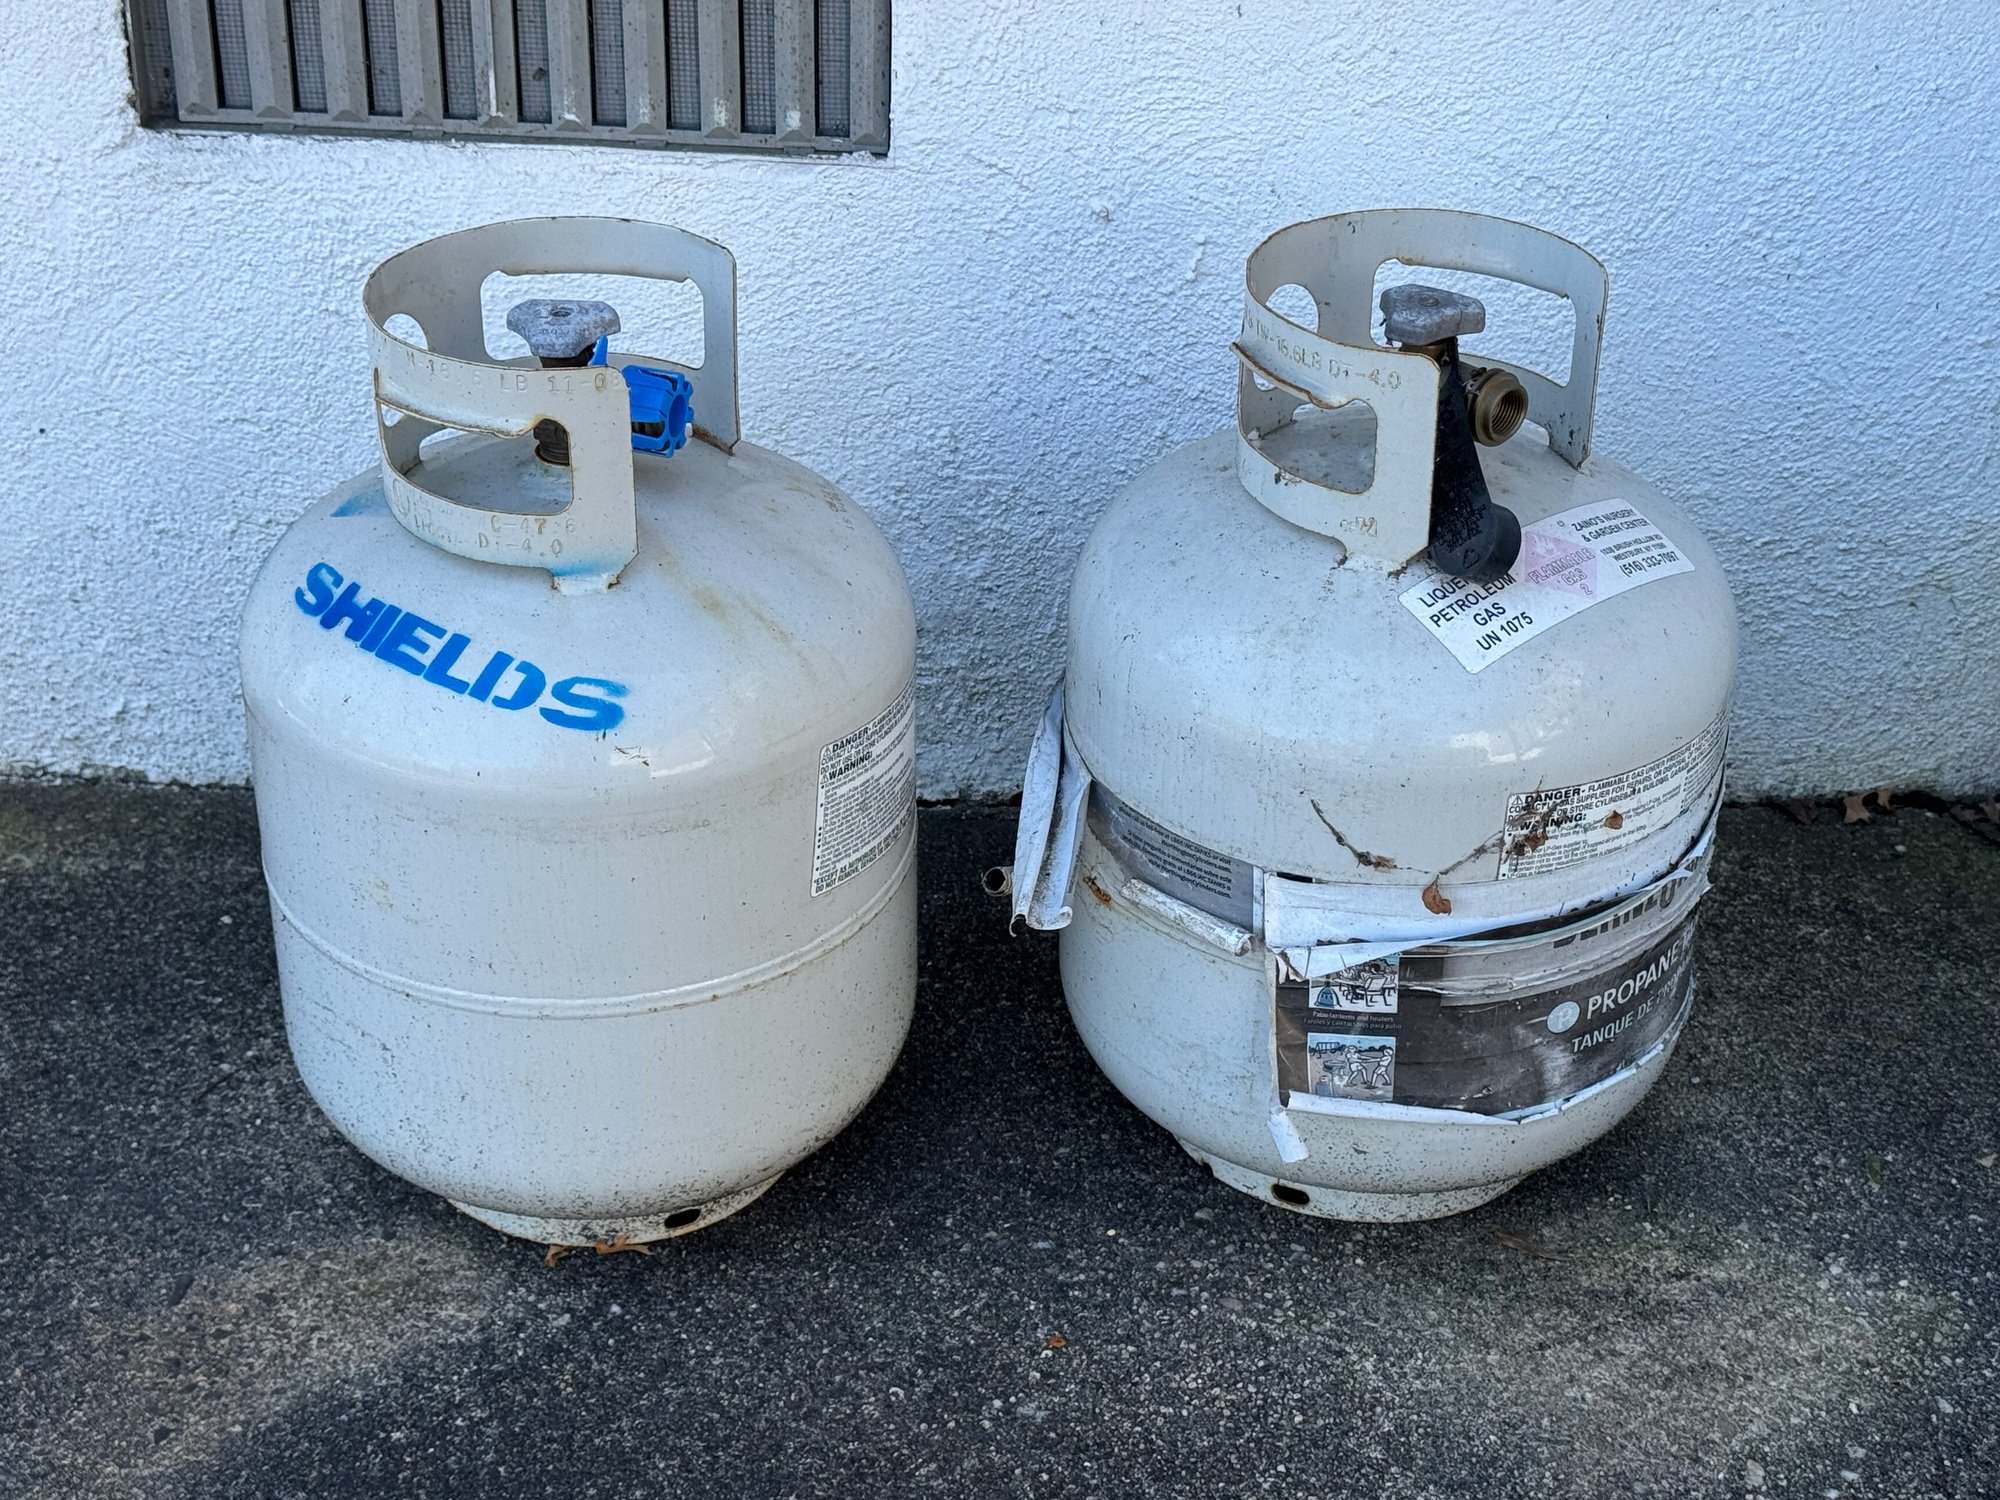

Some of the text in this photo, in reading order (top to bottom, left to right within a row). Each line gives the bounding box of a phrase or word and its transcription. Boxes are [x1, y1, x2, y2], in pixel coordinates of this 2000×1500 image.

[1571, 508, 1637, 532] ZAINO'S NURSERY
[1581, 517, 1651, 543] & GARDEN CENTER
[1528, 547, 1596, 585] FLAMMABLE
[1560, 567, 1588, 586] GAS
[1620, 559, 1648, 578] (516)
[1429, 572, 1517, 628] PETROLEUM
[1579, 583, 1593, 596] 2
[1473, 602, 1507, 627] GAS
[294, 562, 630, 731] SHIELDS
[1476, 611, 1534, 651] UN 1075
[828, 750, 873, 781] WARNING!
[1588, 773, 1630, 792] FLAMMABLE
[1631, 768, 1645, 780] GAS
[1645, 760, 1665, 775] UNDER
[1586, 939, 1680, 1021] PROPANE
[1571, 1011, 1634, 1053] TANQUE
[1636, 996, 1655, 1021] DE
